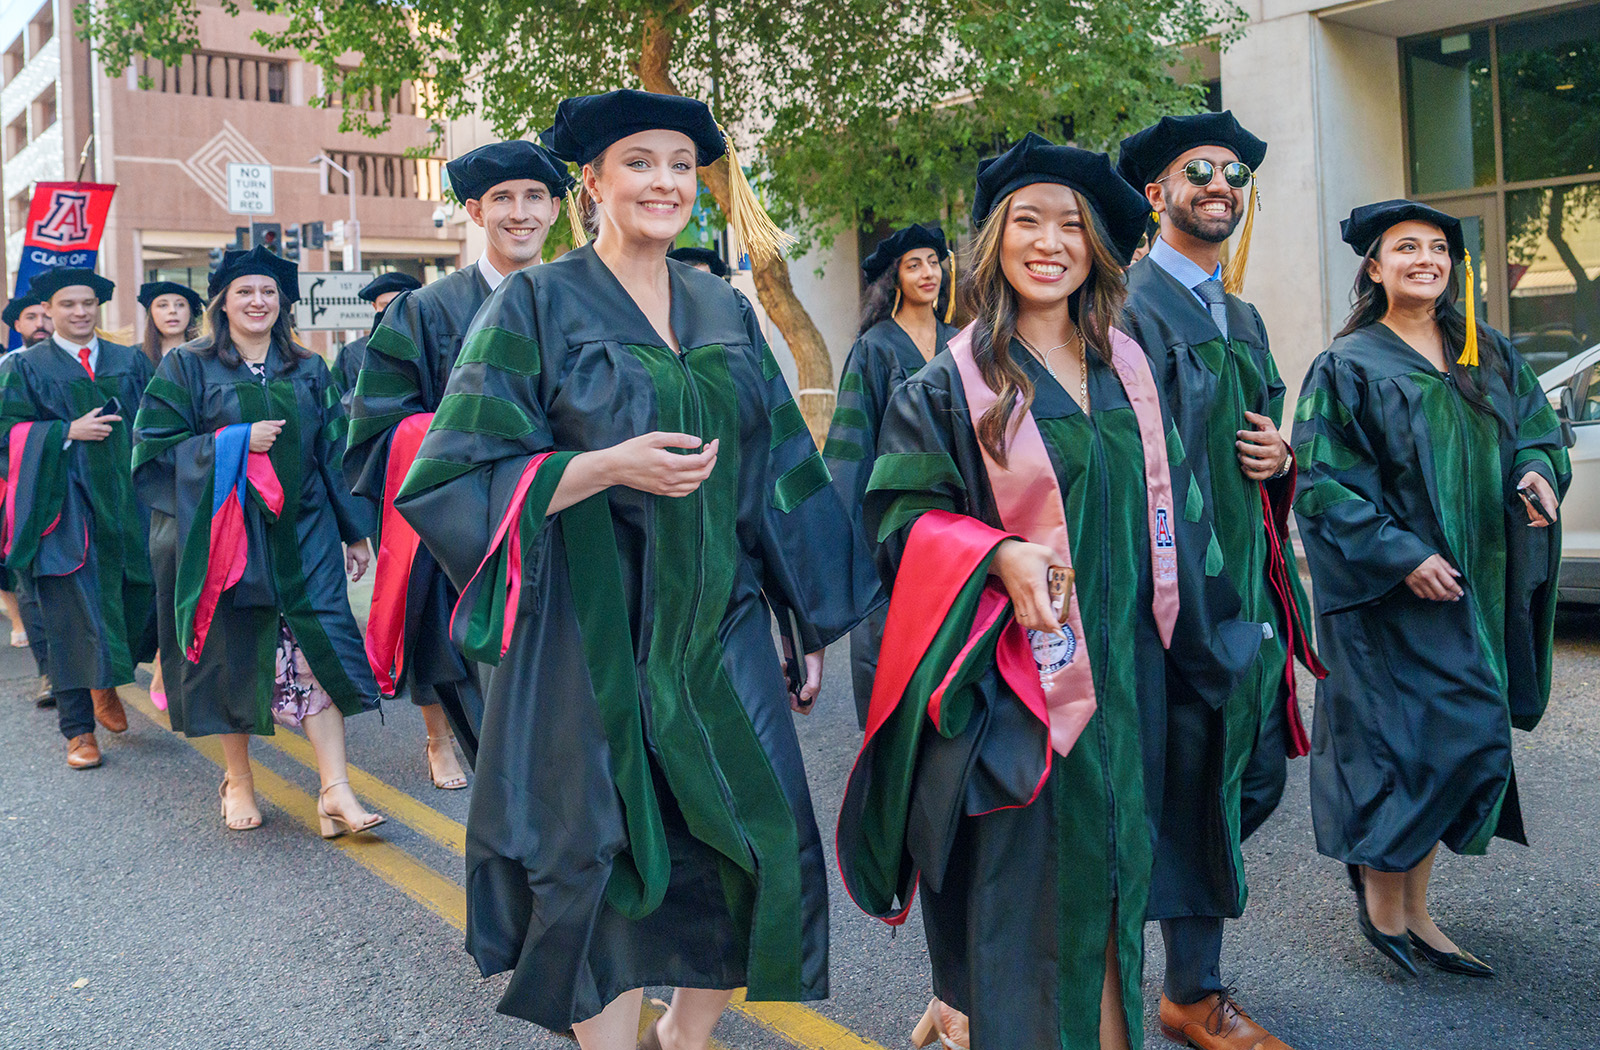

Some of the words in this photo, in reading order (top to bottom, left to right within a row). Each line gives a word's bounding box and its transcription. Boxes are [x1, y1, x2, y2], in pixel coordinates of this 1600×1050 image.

[240, 167, 260, 178] NO
[236, 180, 266, 189] TURN
[243, 190, 259, 199] ON
[240, 200, 263, 210] RED
[32, 190, 92, 246] A
[31, 251, 67, 266] CLASS
[69, 253, 87, 265] OF
[1156, 508, 1174, 548] A
